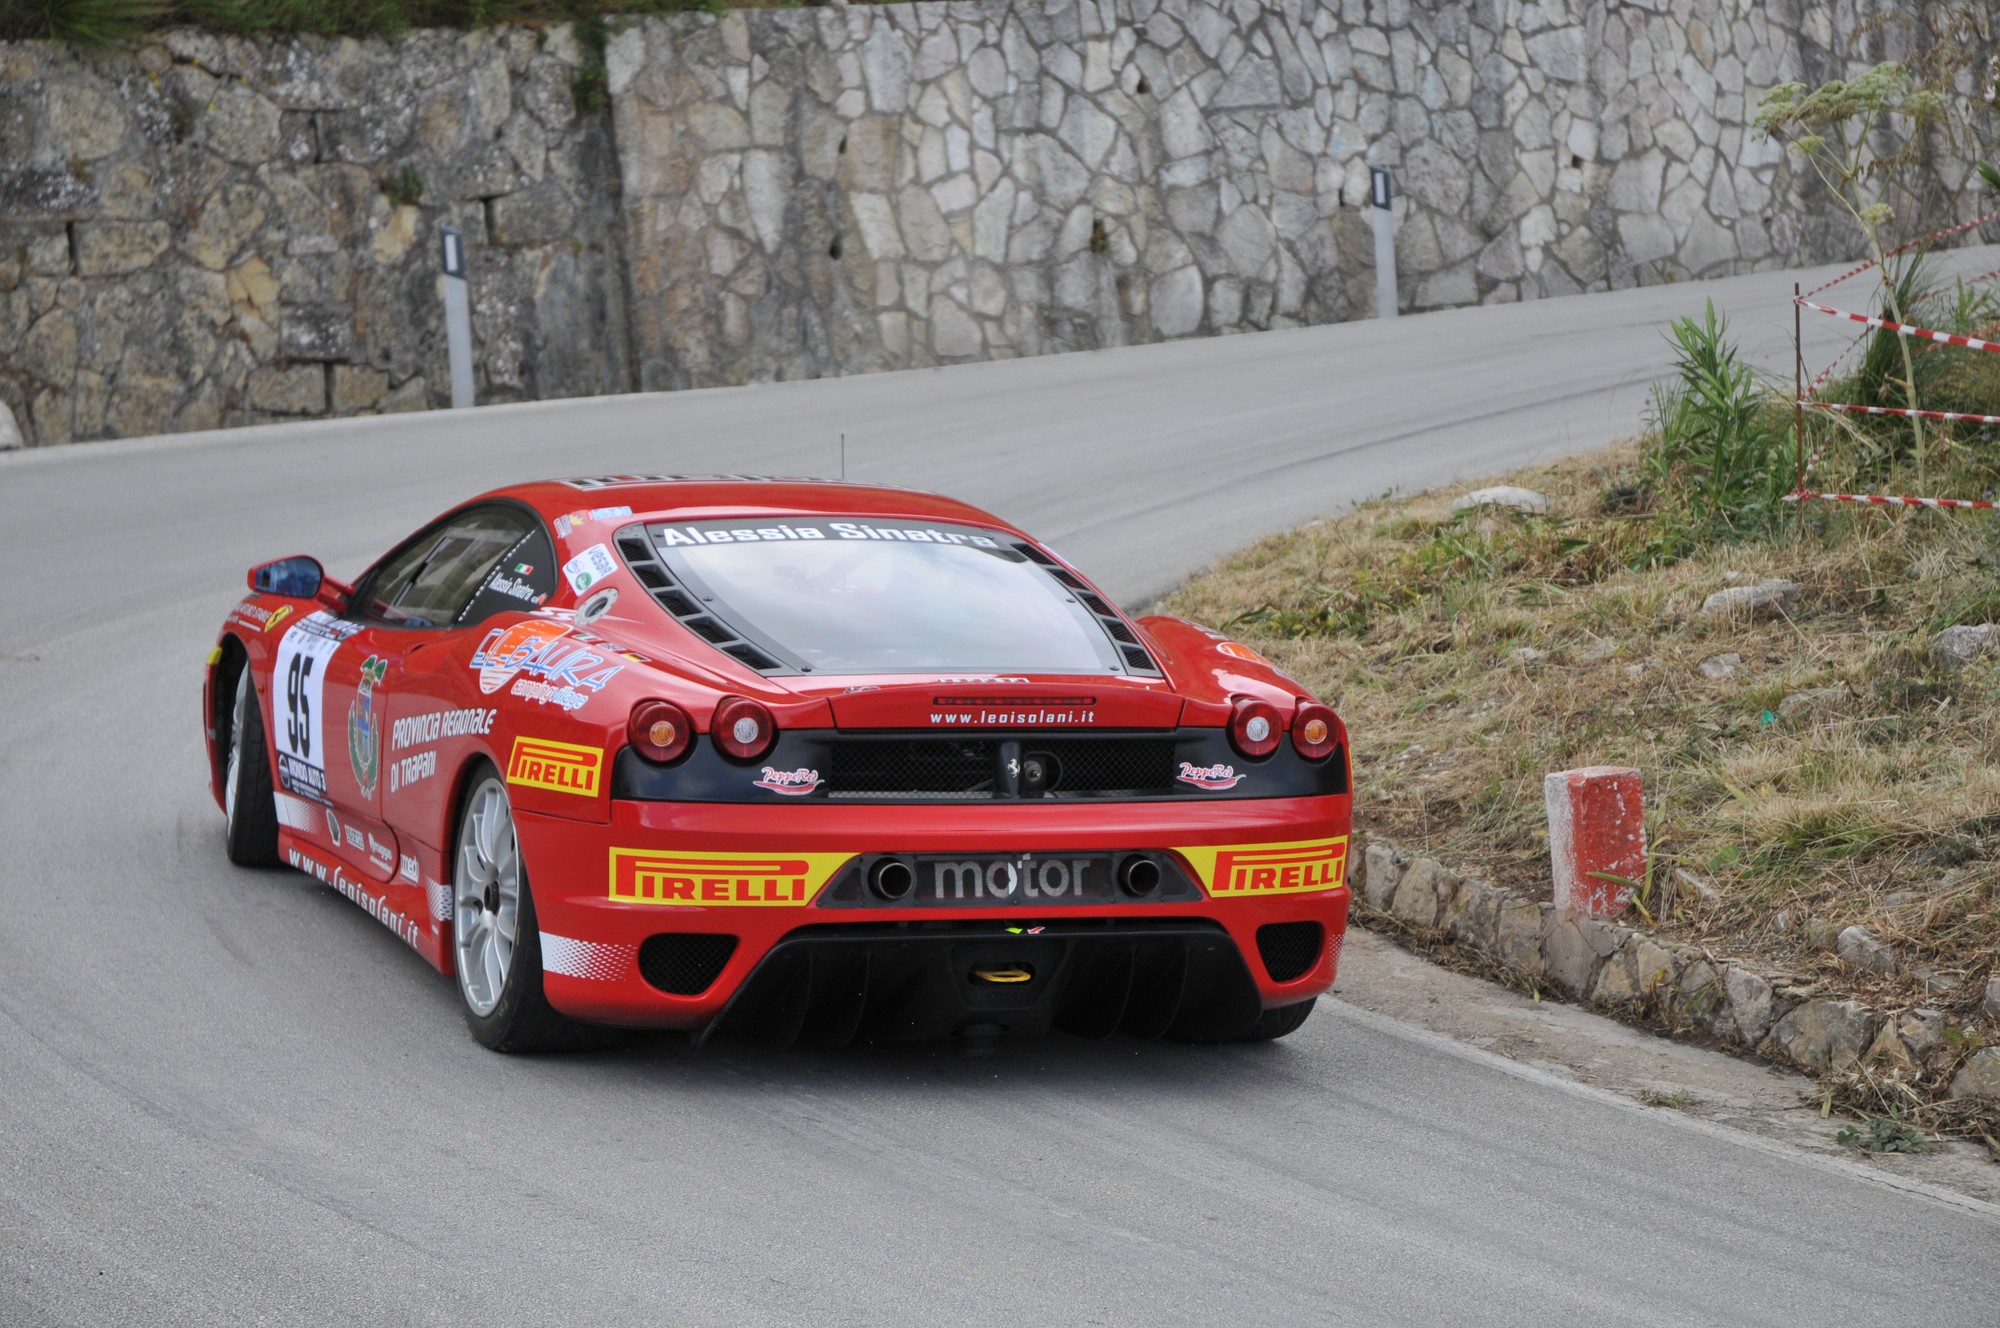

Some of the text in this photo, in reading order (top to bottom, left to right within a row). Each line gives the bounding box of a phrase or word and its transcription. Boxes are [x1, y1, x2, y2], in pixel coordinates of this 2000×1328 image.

[663, 522, 1000, 549] Alessia Sinatra
[287, 652, 314, 759] 95
[929, 709, 1096, 725] www.leoisolani.it
[509, 741, 598, 791] PIRELLI
[615, 853, 810, 901] PIRELLI
[934, 853, 1091, 899] motor
[1211, 841, 1346, 891] PIRELLI
